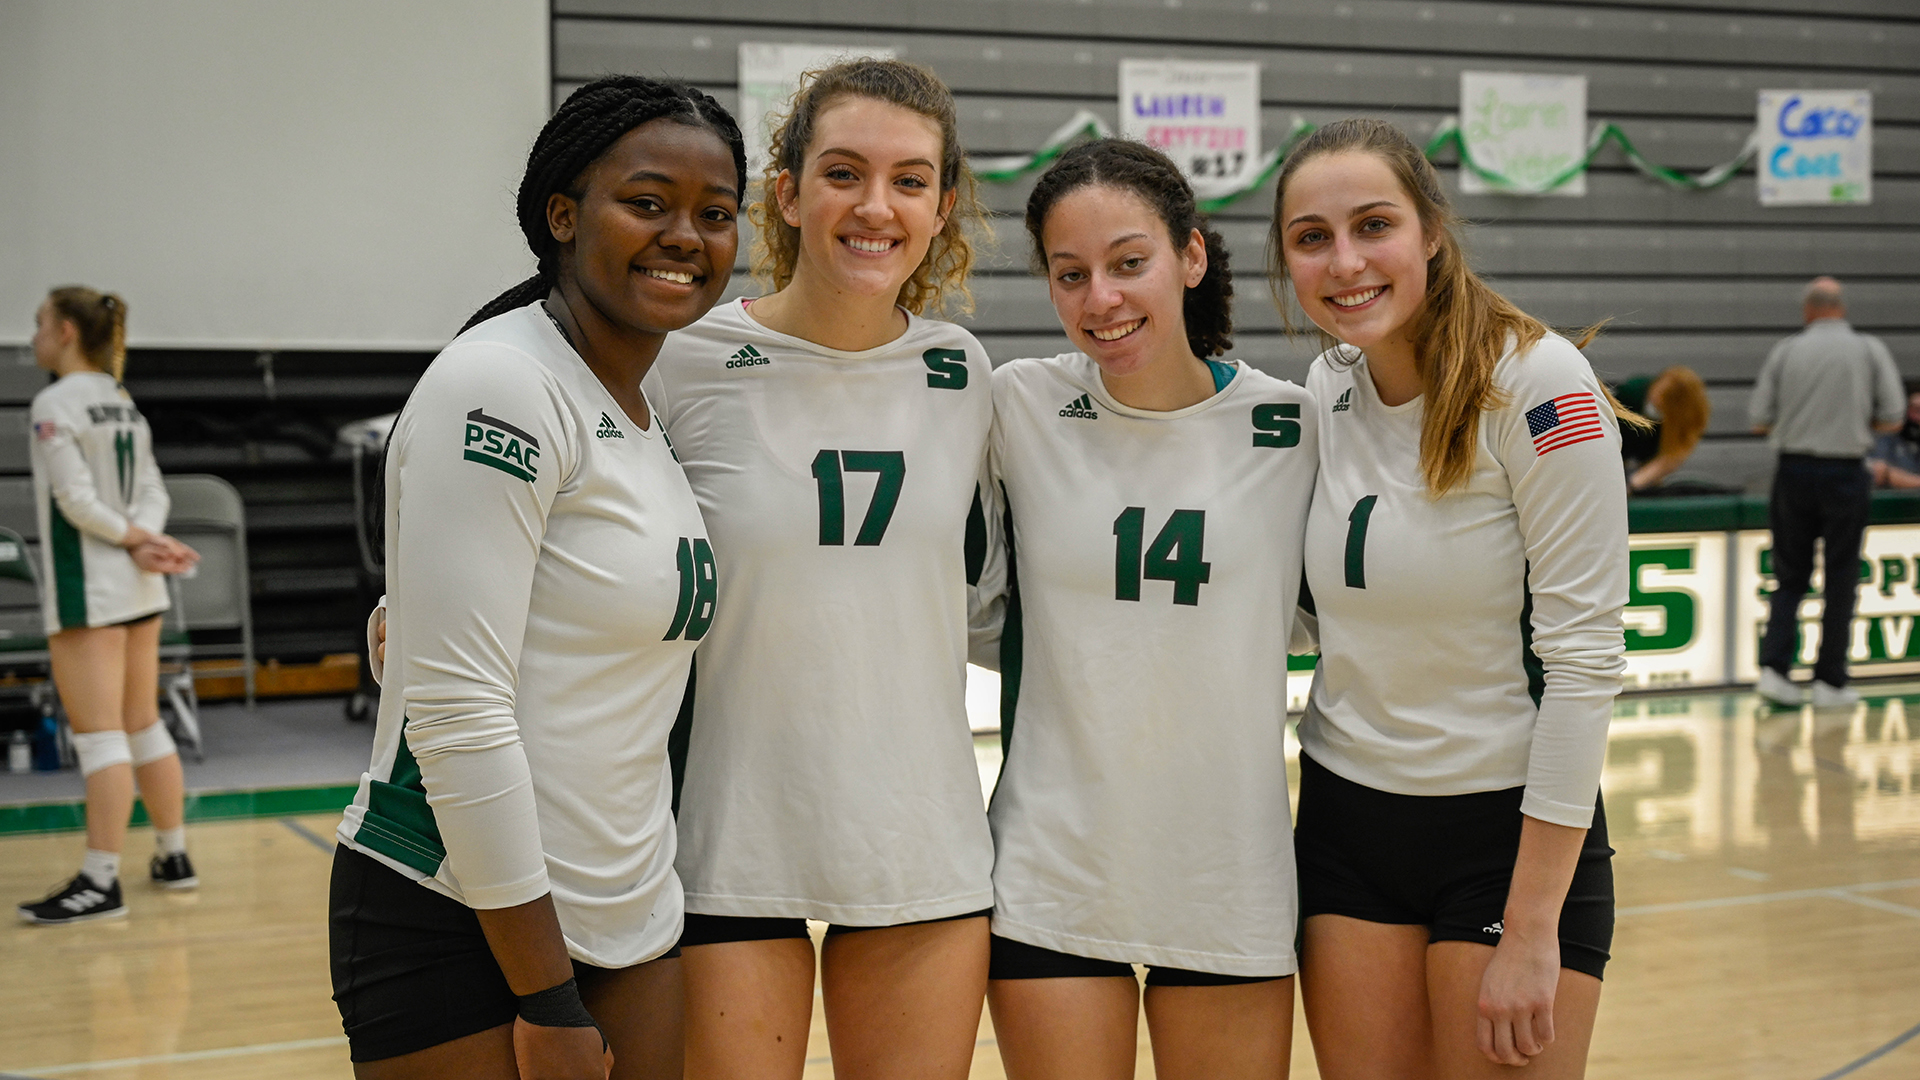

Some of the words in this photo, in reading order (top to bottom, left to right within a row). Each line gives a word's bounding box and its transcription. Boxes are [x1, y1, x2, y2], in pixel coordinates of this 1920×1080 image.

[1134, 93, 1225, 118] LAUREN
[1192, 151, 1244, 177] #17
[725, 356, 771, 369] adidas
[922, 347, 968, 390] S
[596, 427, 624, 439] adidas
[1058, 406, 1098, 420] adidas
[1251, 403, 1302, 448] S
[464, 423, 540, 475] PSAC
[811, 449, 906, 546] 17
[1113, 506, 1211, 606] 14
[1344, 495, 1379, 589] 1
[661, 537, 718, 642] 18
